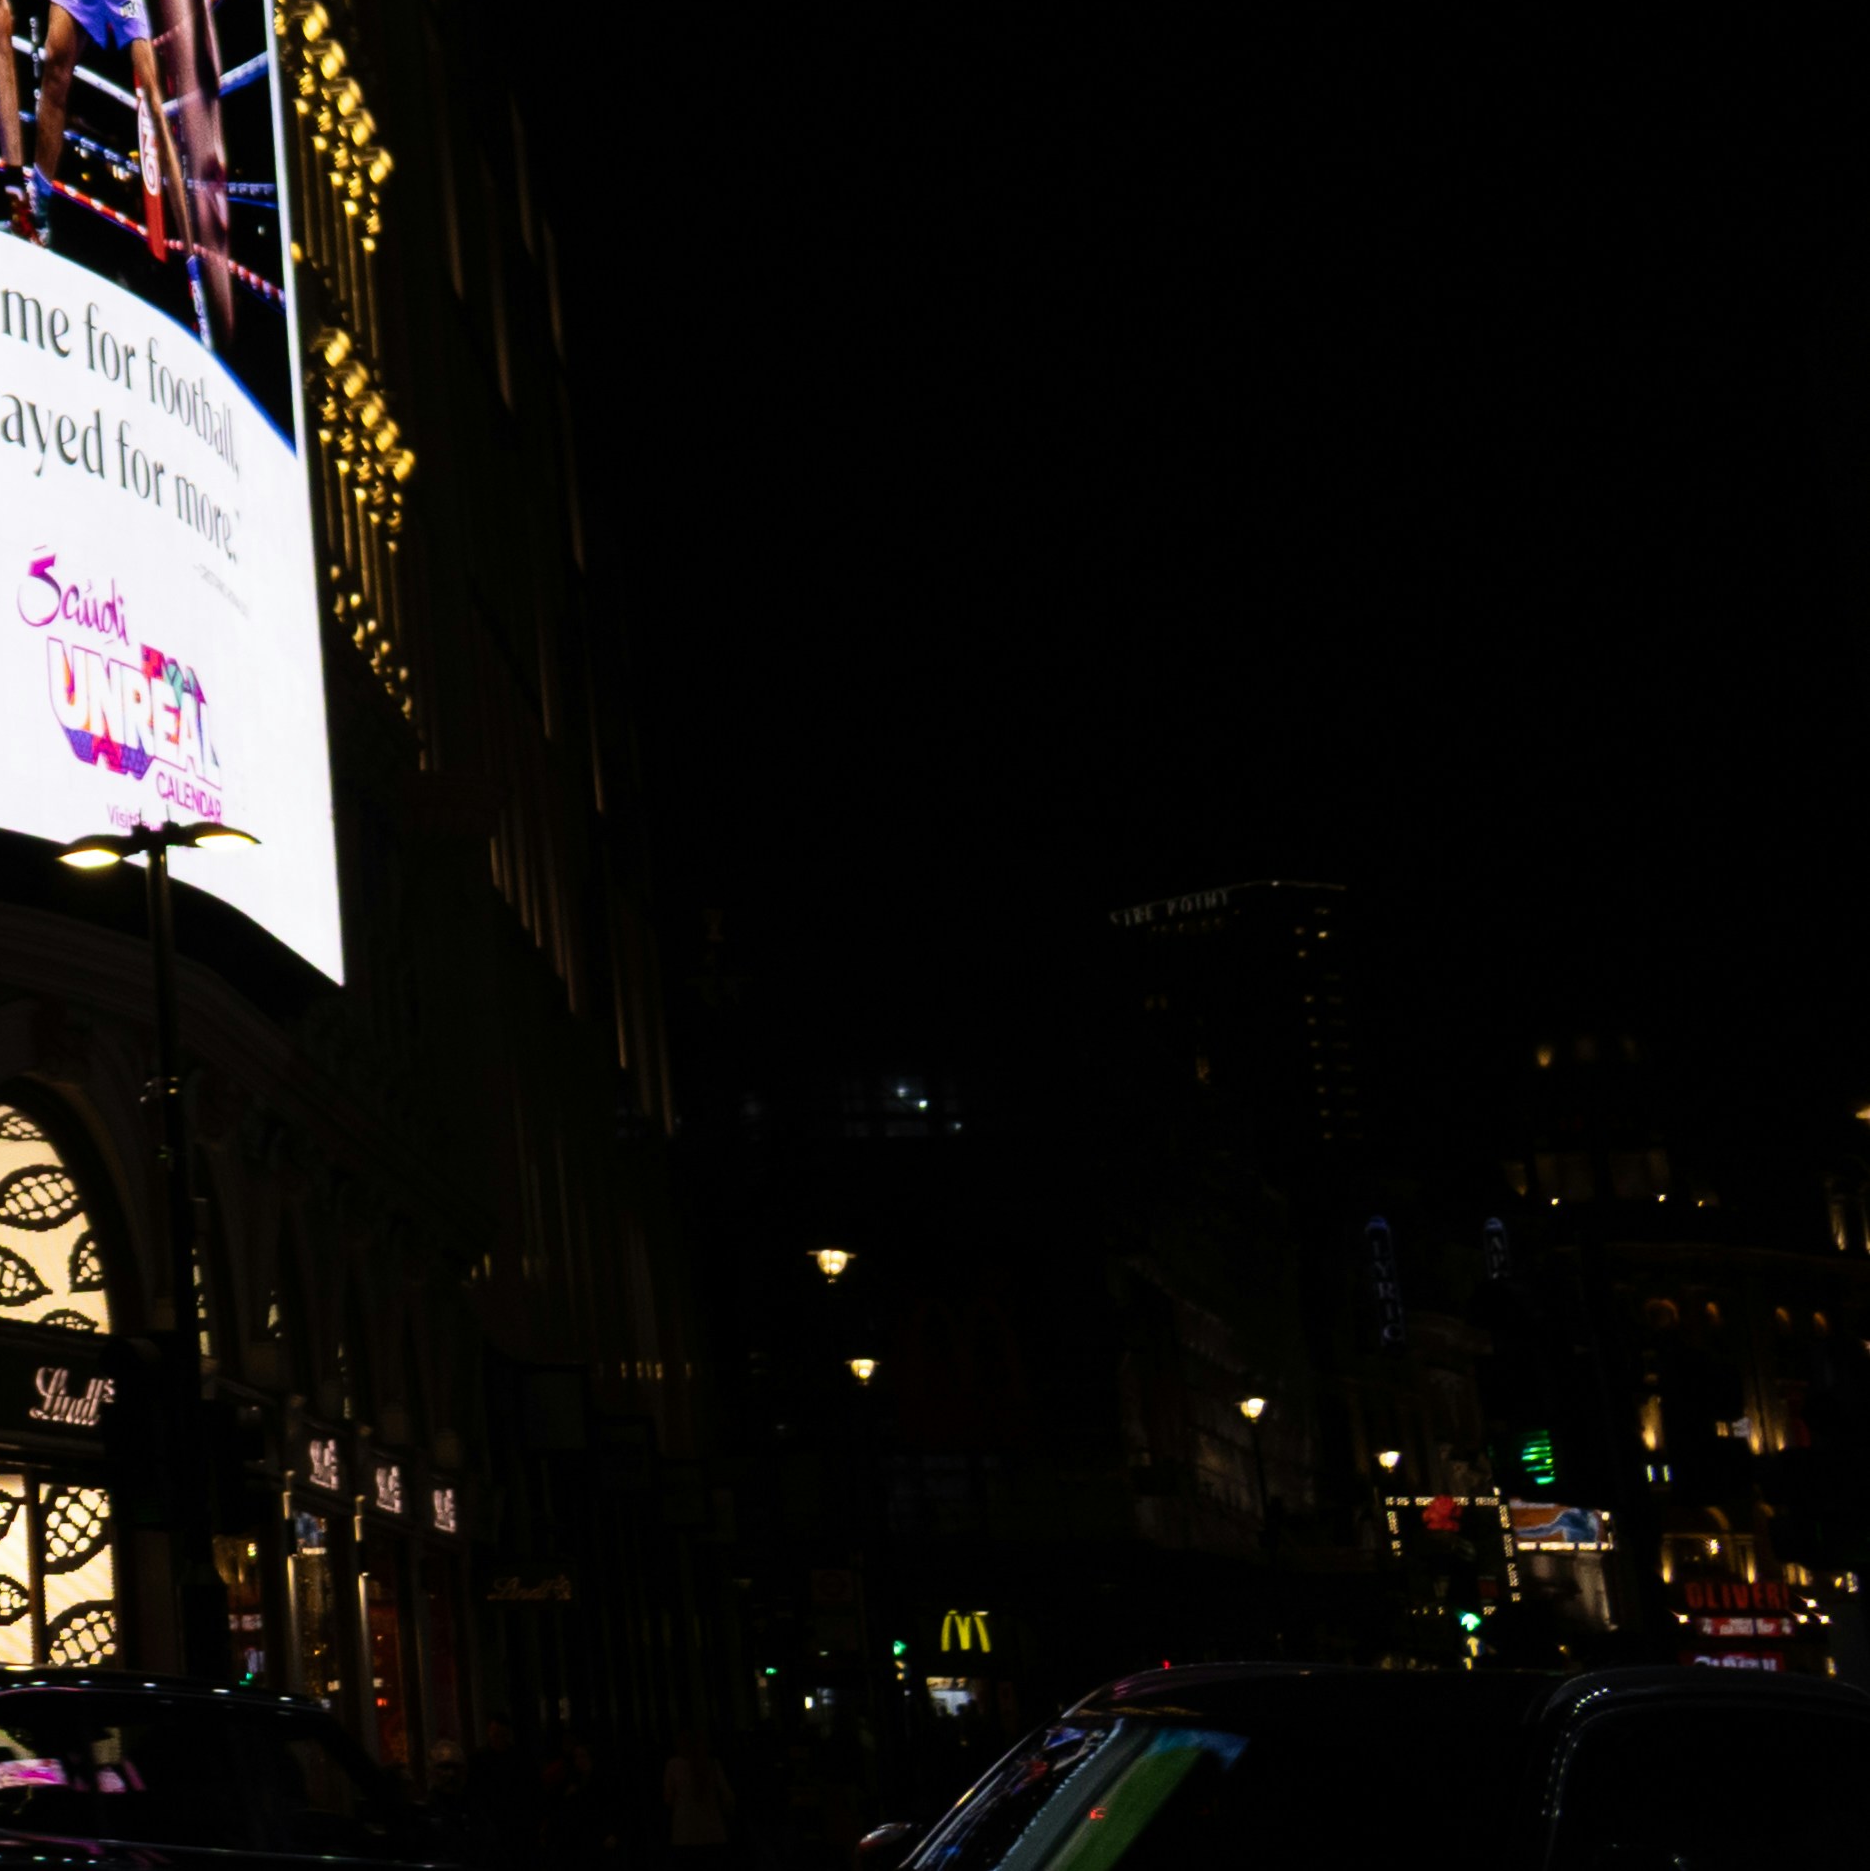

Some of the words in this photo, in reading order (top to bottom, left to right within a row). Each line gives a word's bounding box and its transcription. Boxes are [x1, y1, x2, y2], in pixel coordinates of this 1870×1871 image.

[83, 301, 137, 391] for
[145, 336, 241, 483] football,
[115, 419, 166, 508] for
[17, 545, 130, 647] Saudi
[46, 636, 224, 790] UNREAL
[155, 770, 222, 825] CALENDAR
[28, 1366, 103, 1427] Lindt
